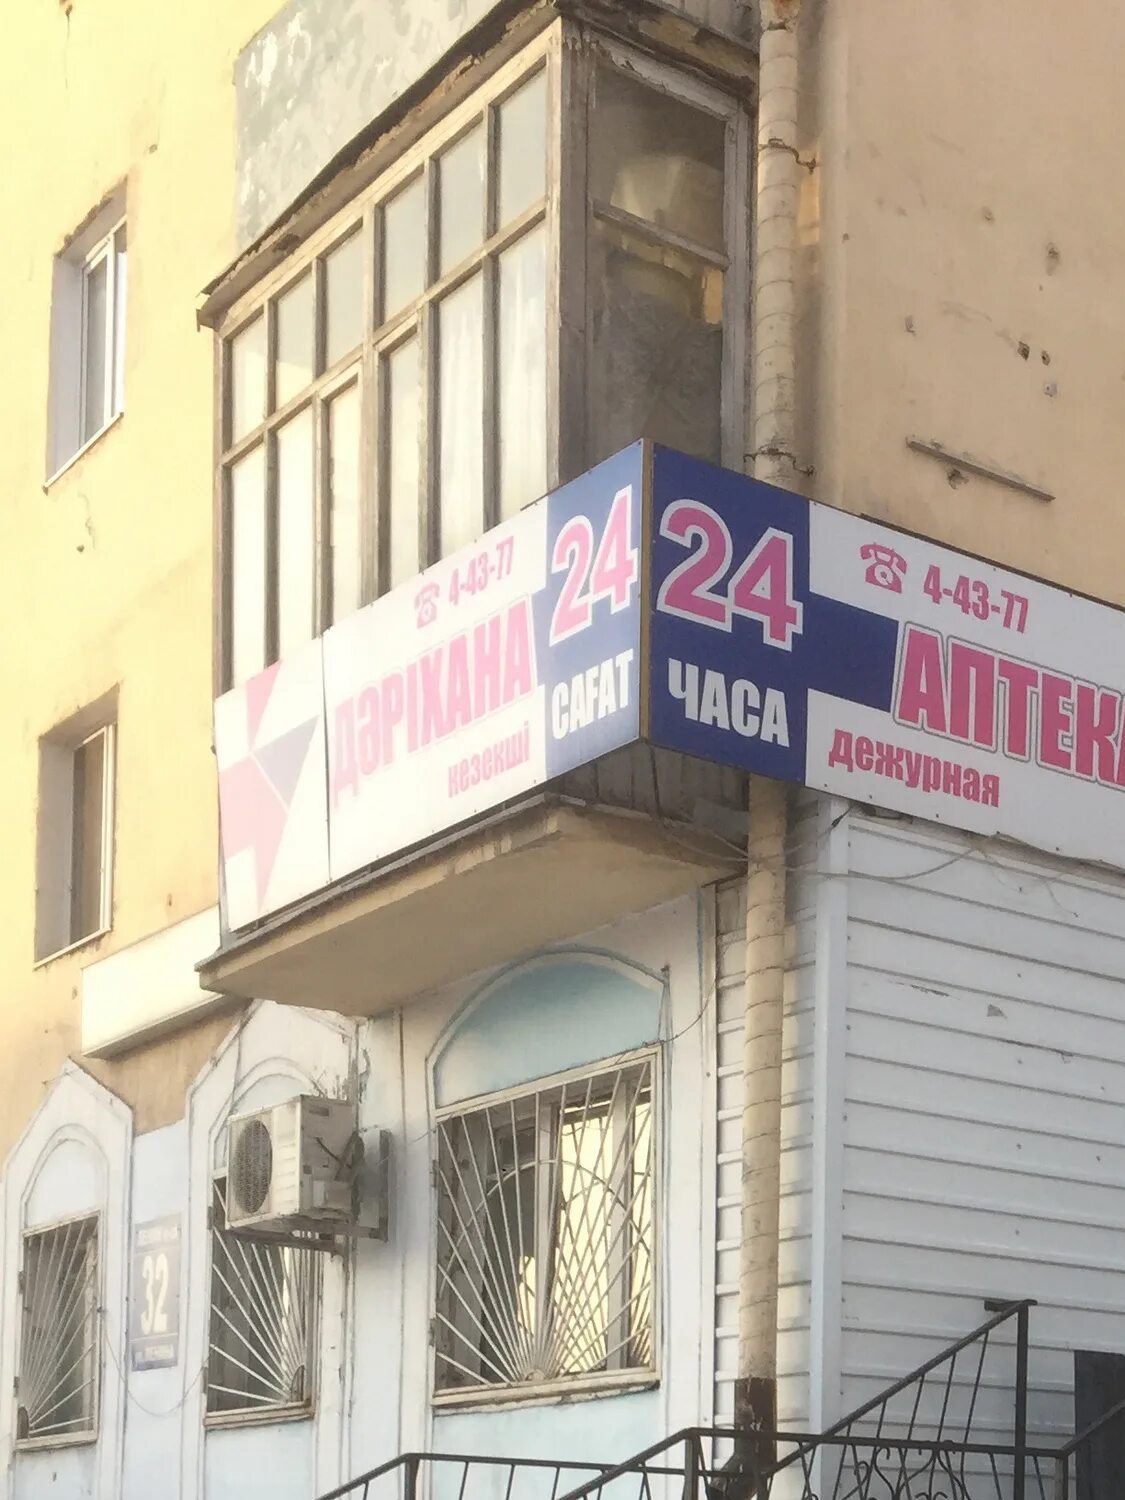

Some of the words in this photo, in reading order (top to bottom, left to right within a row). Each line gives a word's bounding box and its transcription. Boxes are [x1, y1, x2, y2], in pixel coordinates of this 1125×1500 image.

[449, 535, 514, 606] 4-43-77
[550, 485, 638, 646] 24
[656, 499, 803, 651] 24
[923, 565, 1029, 633] 4-43-77
[332, 599, 533, 808] ДӘРІХАНА
[667, 658, 790, 748] ЧАСА
[448, 720, 531, 799] кезекші
[828, 728, 1000, 808] дежурная
[141, 1253, 168, 1335] 32
